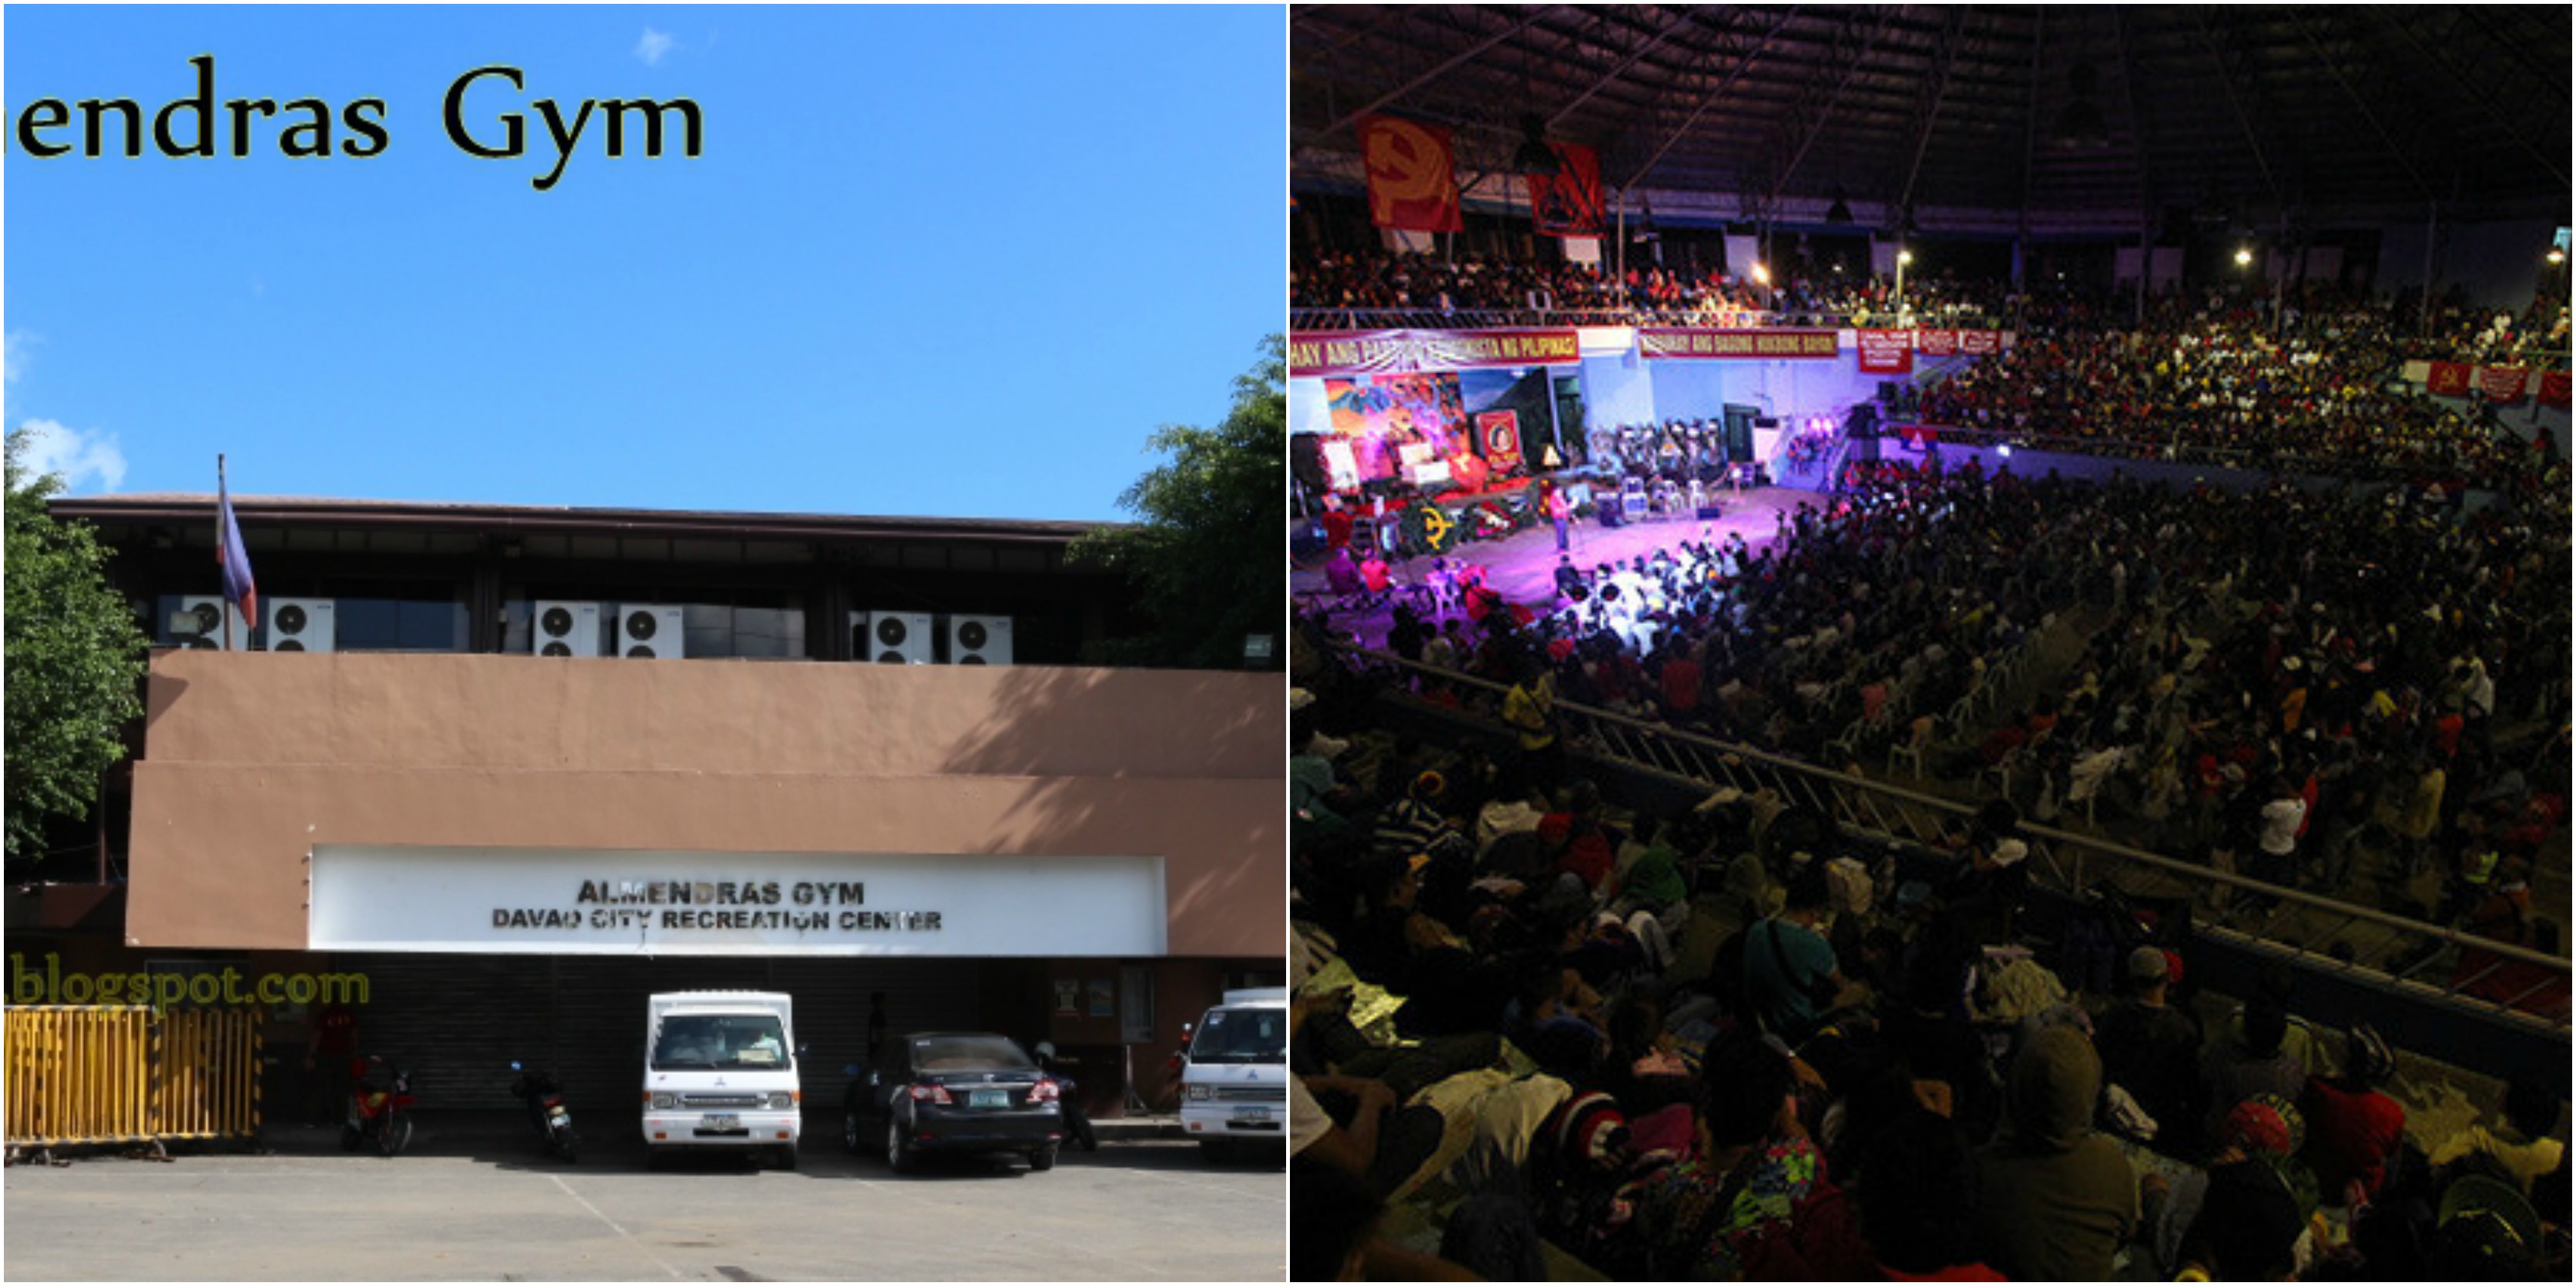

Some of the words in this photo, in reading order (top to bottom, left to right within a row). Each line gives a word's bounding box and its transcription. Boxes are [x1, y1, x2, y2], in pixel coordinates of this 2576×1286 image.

[1327, 340, 1360, 365] ANG
[1501, 338, 1518, 358] NG
[577, 880, 781, 905] ALMENDRAS
[792, 882, 864, 905] GYM
[492, 909, 582, 929] DAVAO
[590, 909, 652, 929] CITY
[662, 910, 830, 931] RECREATION
[838, 911, 942, 931] CENTER
